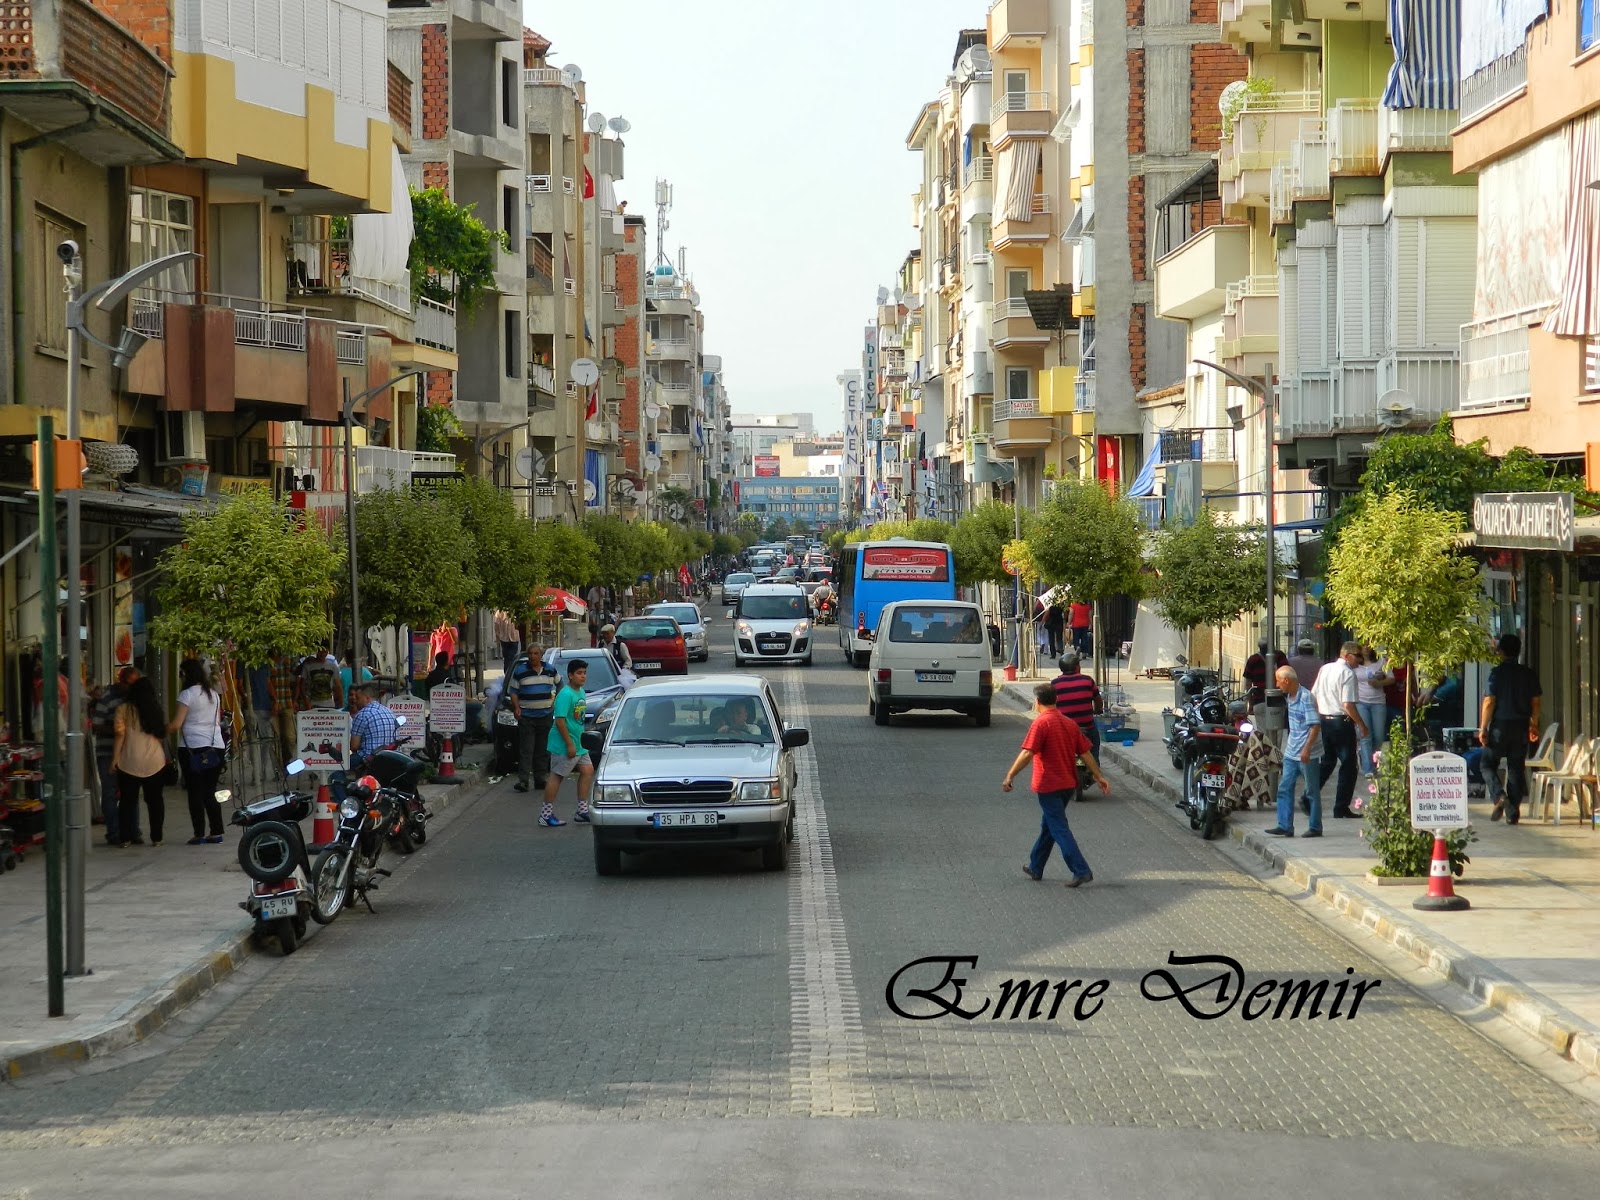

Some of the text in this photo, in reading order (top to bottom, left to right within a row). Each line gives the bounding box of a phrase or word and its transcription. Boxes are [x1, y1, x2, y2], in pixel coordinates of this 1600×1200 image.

[867, 343, 875, 404] birey
[1520, 503, 1557, 538] AHMET
[1414, 764, 1463, 773] Yenilenen Kadromuzda
[1415, 777, 1462, 787] AS SAÇ TASARIM
[1417, 789, 1431, 799] Adem
[1432, 790, 1436, 799] &
[1419, 802, 1456, 811] Birlikte Sizlere
[661, 813, 715, 825] 35 HPA 86
[1416, 814, 1431, 822] Hizmet
[264, 900, 276, 909] 45
